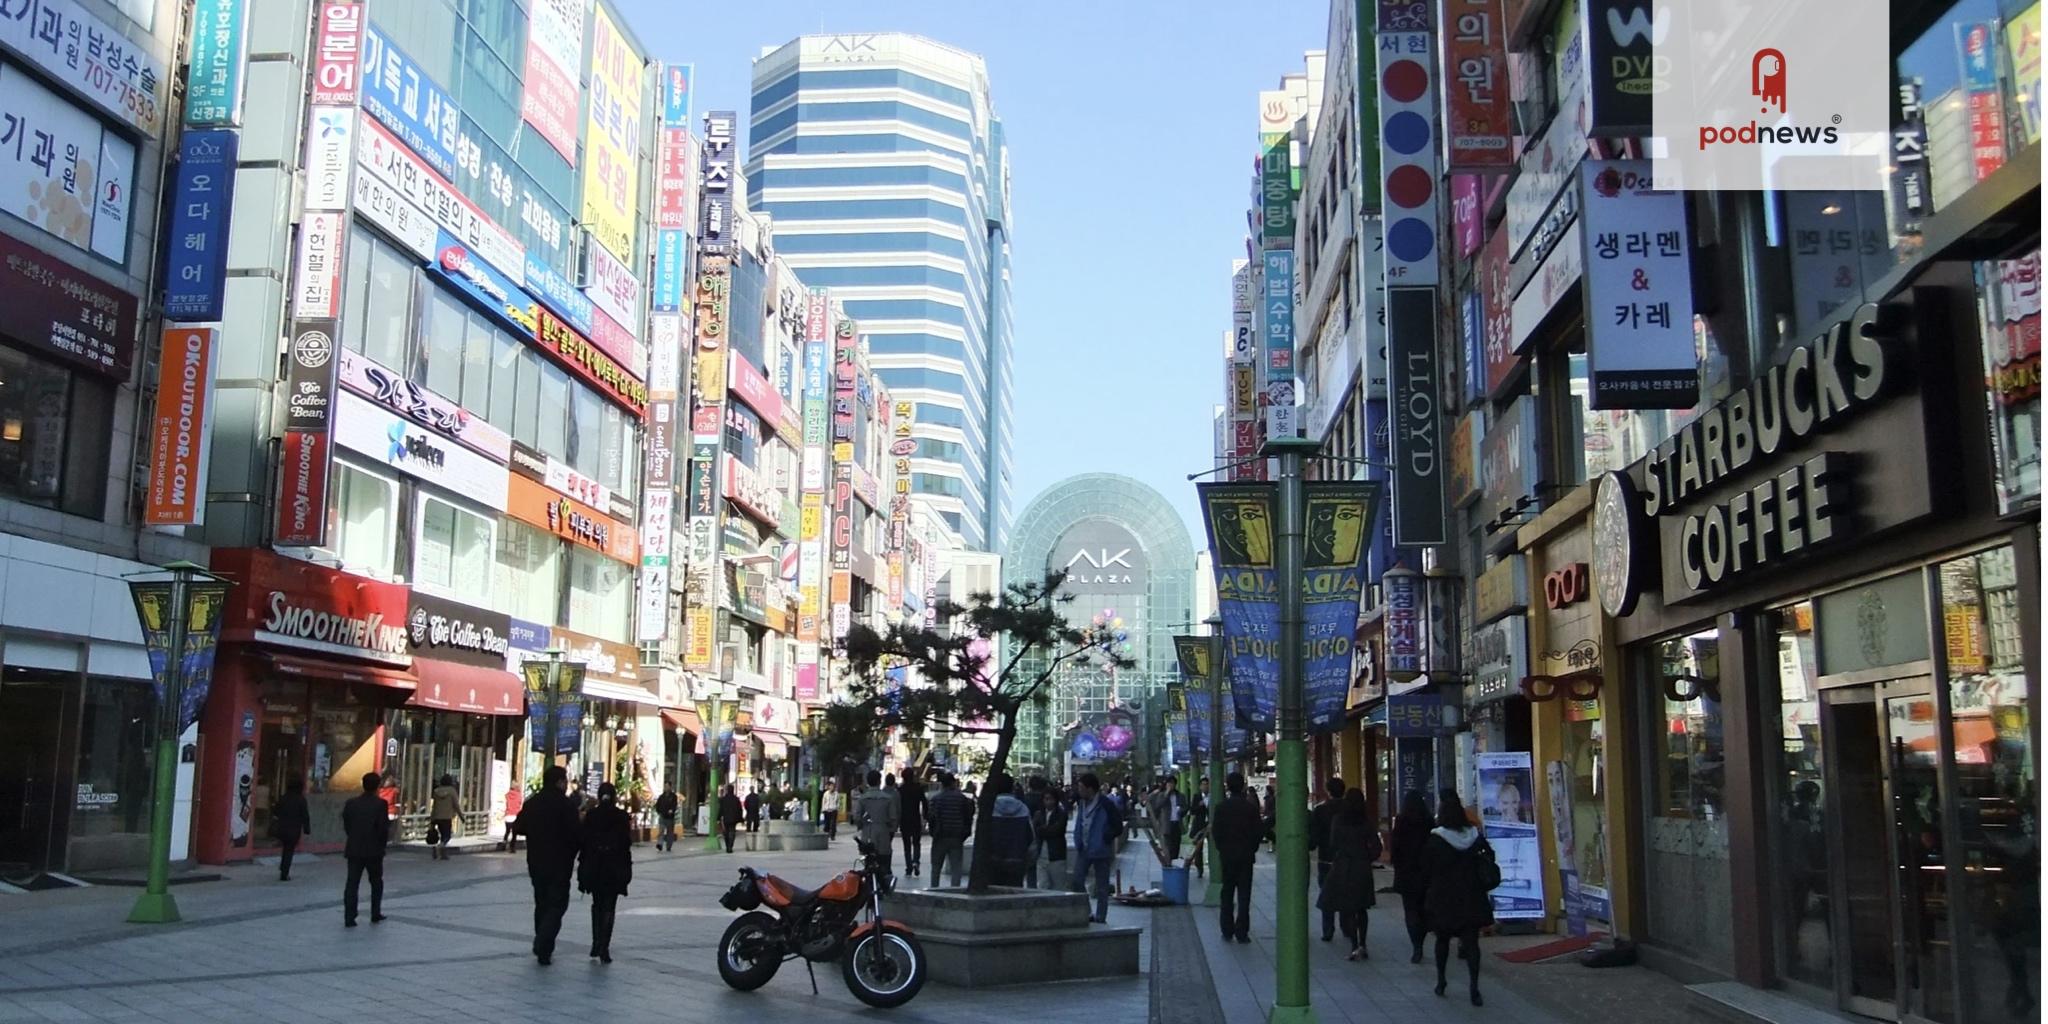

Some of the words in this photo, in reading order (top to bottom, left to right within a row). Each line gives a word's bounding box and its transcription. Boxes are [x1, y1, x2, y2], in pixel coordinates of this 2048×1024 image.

[320, 5, 360, 90] 일본어
[1380, 35, 1428, 53] 서현
[1607, 7, 1671, 47] W
[65, 19, 82, 70] 의원
[86, 22, 156, 94] 남성수술
[597, 17, 639, 111] 에비스
[1456, 0, 1493, 104] 의원
[1612, 56, 1672, 78] DVD
[84, 57, 155, 123] 707-7533
[192, 85, 206, 97] 3F
[192, 106, 226, 120] 신경과
[364, 28, 420, 122] 기독교
[424, 87, 457, 155] 서점
[592, 73, 638, 165] 일본어
[63, 143, 80, 195] 의원
[706, 118, 730, 188] 루즈
[387, 151, 417, 198] 서현
[424, 179, 464, 236] 헌혈의
[468, 207, 482, 249] 집
[598, 144, 628, 216] 학원
[1266, 151, 1290, 229] 대중탕
[181, 173, 212, 284] 오다헤어
[1595, 231, 1681, 259] 생라멘
[1388, 267, 1408, 278] 4F
[1632, 268, 1650, 291] &
[810, 296, 825, 342] MOTEL
[1269, 255, 1291, 342] 해법수학
[1614, 302, 1670, 329] 카레
[1237, 326, 1248, 352] PC
[290, 394, 327, 407] Coffee
[300, 381, 321, 394] The
[1599, 381, 1650, 392] 오사카음식
[1652, 379, 1683, 391] 전문점
[171, 334, 202, 506] OKOUTDOOR.COM
[290, 406, 325, 419] Bean
[1407, 350, 1434, 478] LLOYD
[1645, 302, 1884, 517] STARBUCKS
[835, 481, 850, 548] PC
[1682, 452, 1832, 590] COFFEE
[1066, 548, 1132, 569] AK
[1066, 575, 1132, 584] PLAZA
[149, 635, 173, 649] AID
[429, 614, 449, 646] The
[450, 623, 482, 650] Coffee
[483, 627, 510, 658] Bean
[1391, 705, 1442, 729] 부동산
